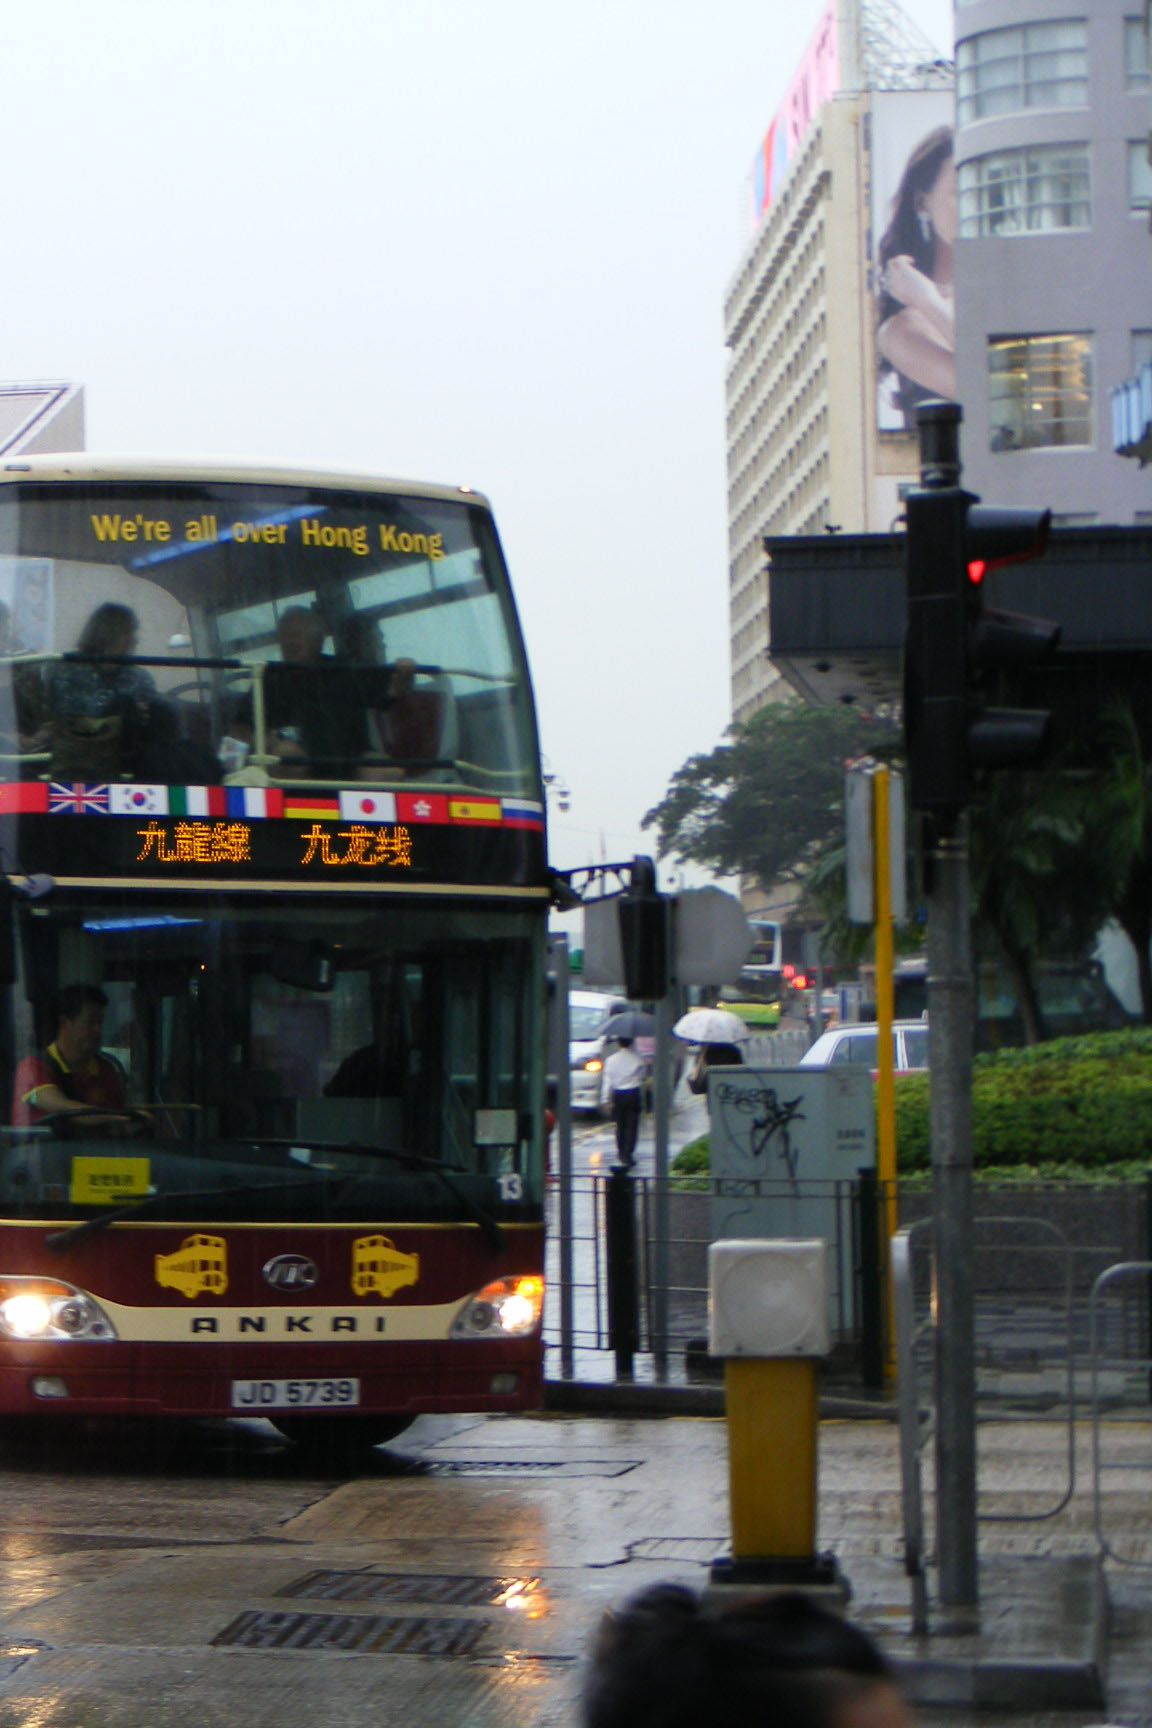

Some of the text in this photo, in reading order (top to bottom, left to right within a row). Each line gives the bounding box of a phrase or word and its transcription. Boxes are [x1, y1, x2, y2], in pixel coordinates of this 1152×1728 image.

[91, 514, 445, 561] We're all over Hong Kong
[137, 820, 251, 862] 九龍線
[496, 1173, 523, 1200] 13
[191, 1316, 386, 1334] ANKAI
[287, 1381, 353, 1403] 5739
